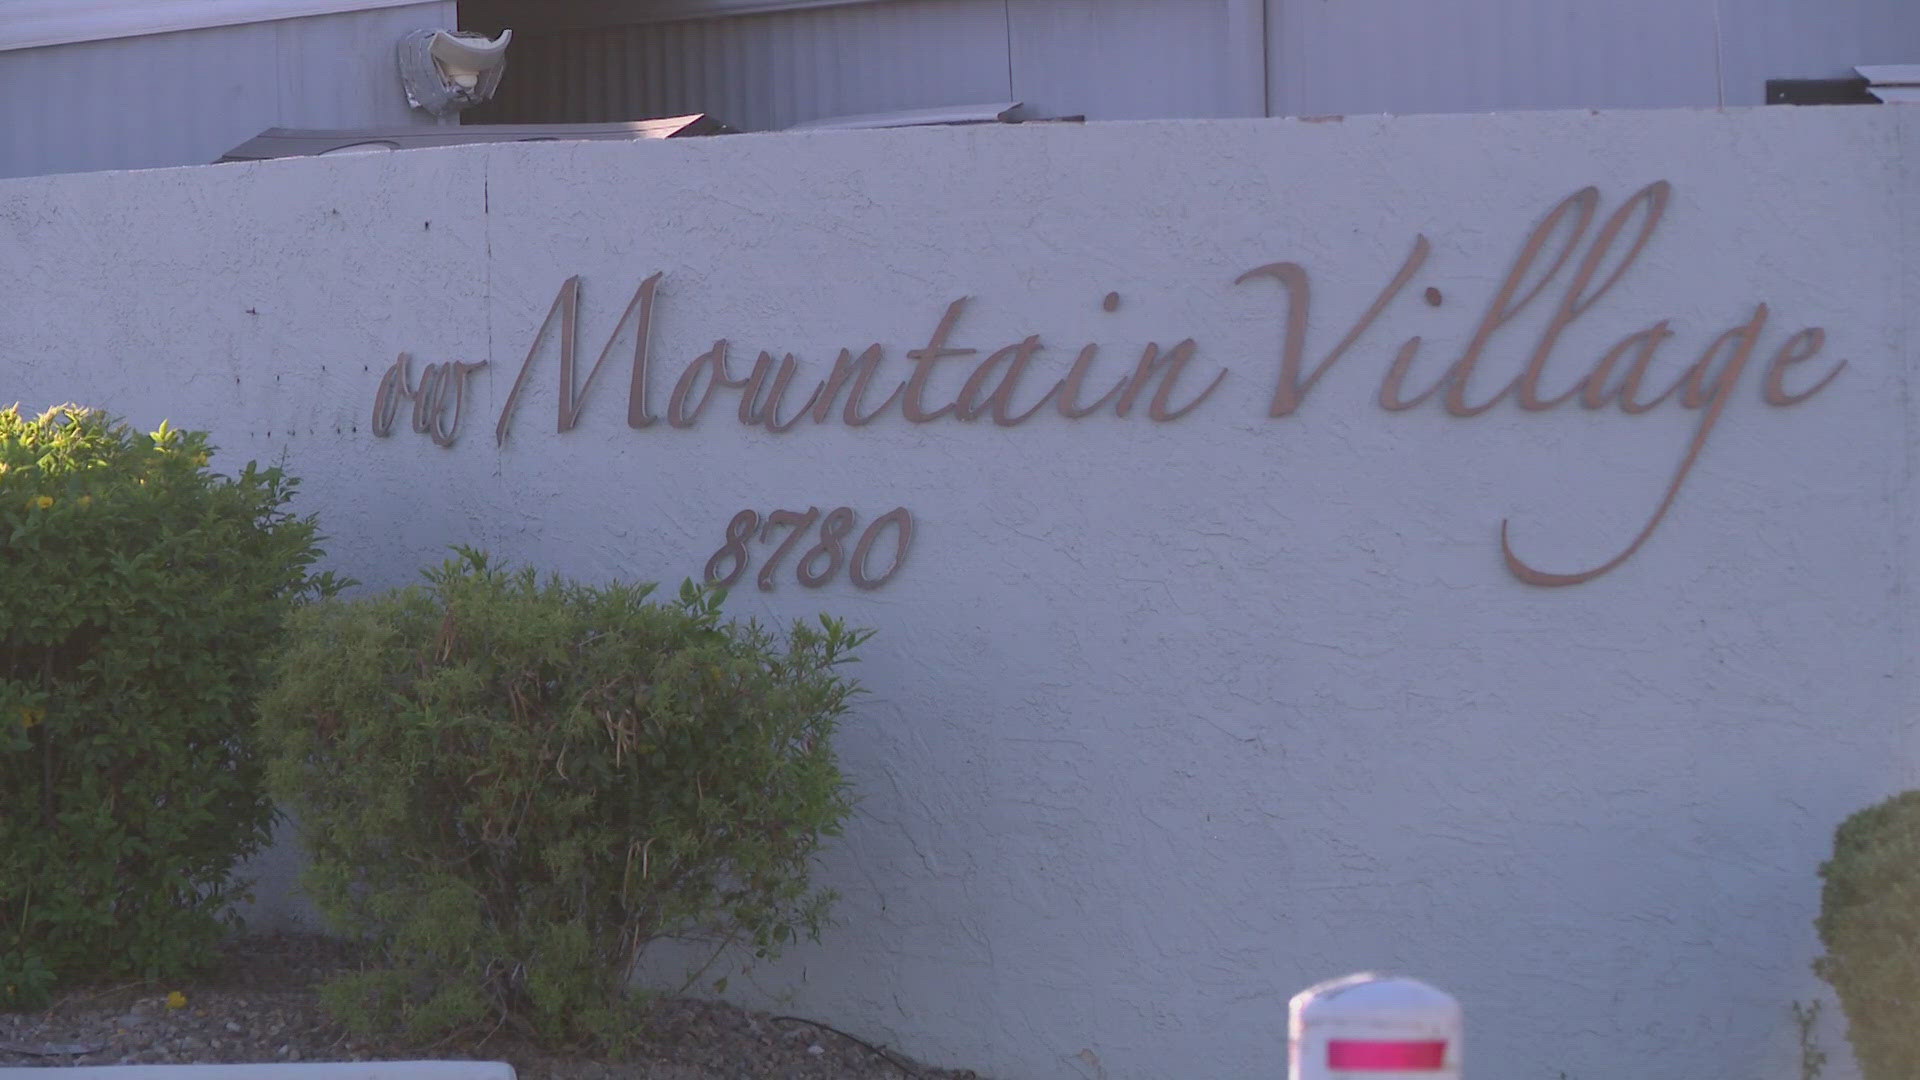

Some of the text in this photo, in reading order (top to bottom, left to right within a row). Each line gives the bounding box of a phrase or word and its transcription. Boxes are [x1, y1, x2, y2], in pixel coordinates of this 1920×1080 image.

[496, 271, 1228, 449] Mountain
[1234, 180, 1848, 587] Village
[704, 506, 915, 592] 8780
